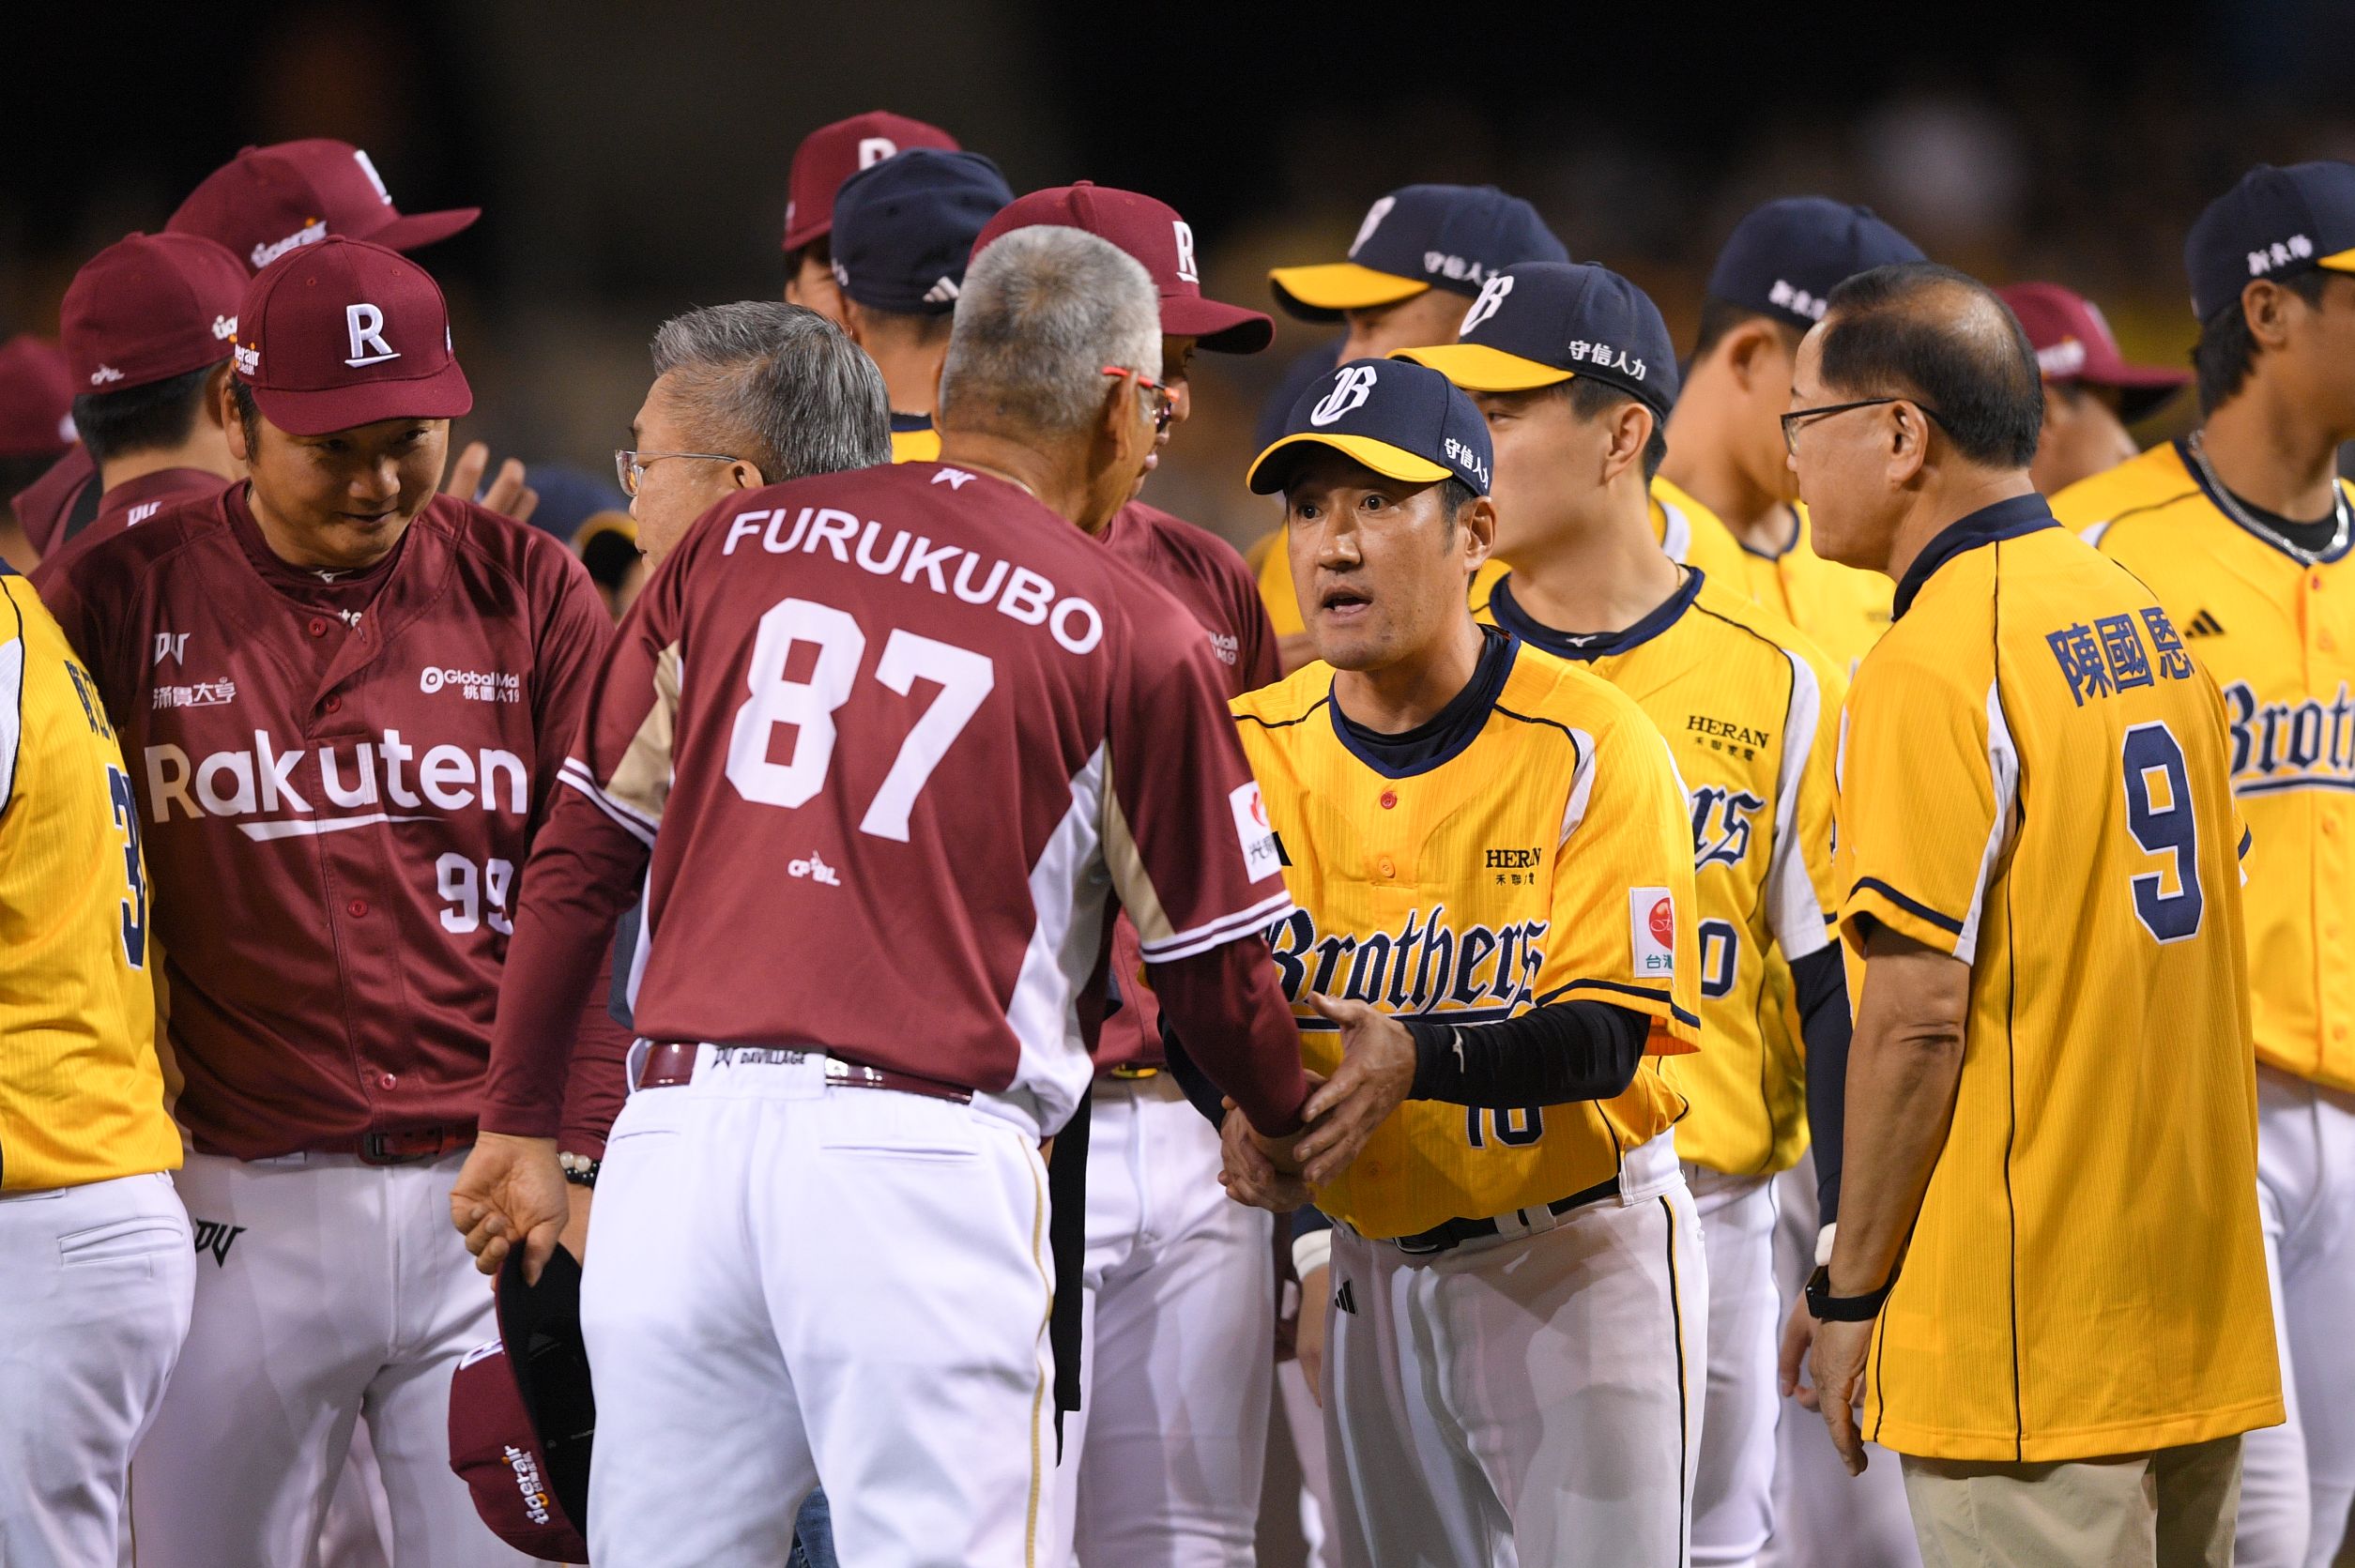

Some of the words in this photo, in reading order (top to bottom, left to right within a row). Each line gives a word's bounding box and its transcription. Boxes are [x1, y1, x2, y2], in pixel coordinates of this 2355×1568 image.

[1172, 221, 1199, 280] R
[346, 303, 393, 358] R
[1568, 340, 1647, 381] 守信人力
[723, 508, 1104, 655] FURUKUBO
[444, 669, 495, 685] Global
[2045, 606, 2195, 708] 陳國恩
[725, 597, 995, 843] 87
[1687, 715, 1769, 749] HERAN
[2225, 679, 2355, 780] Brot
[145, 728, 528, 823] Rakuten
[2122, 720, 2203, 945] 9
[436, 852, 514, 936] 99
[1268, 903, 1552, 1015] Brothers
[501, 1445, 549, 1525] tigerair
